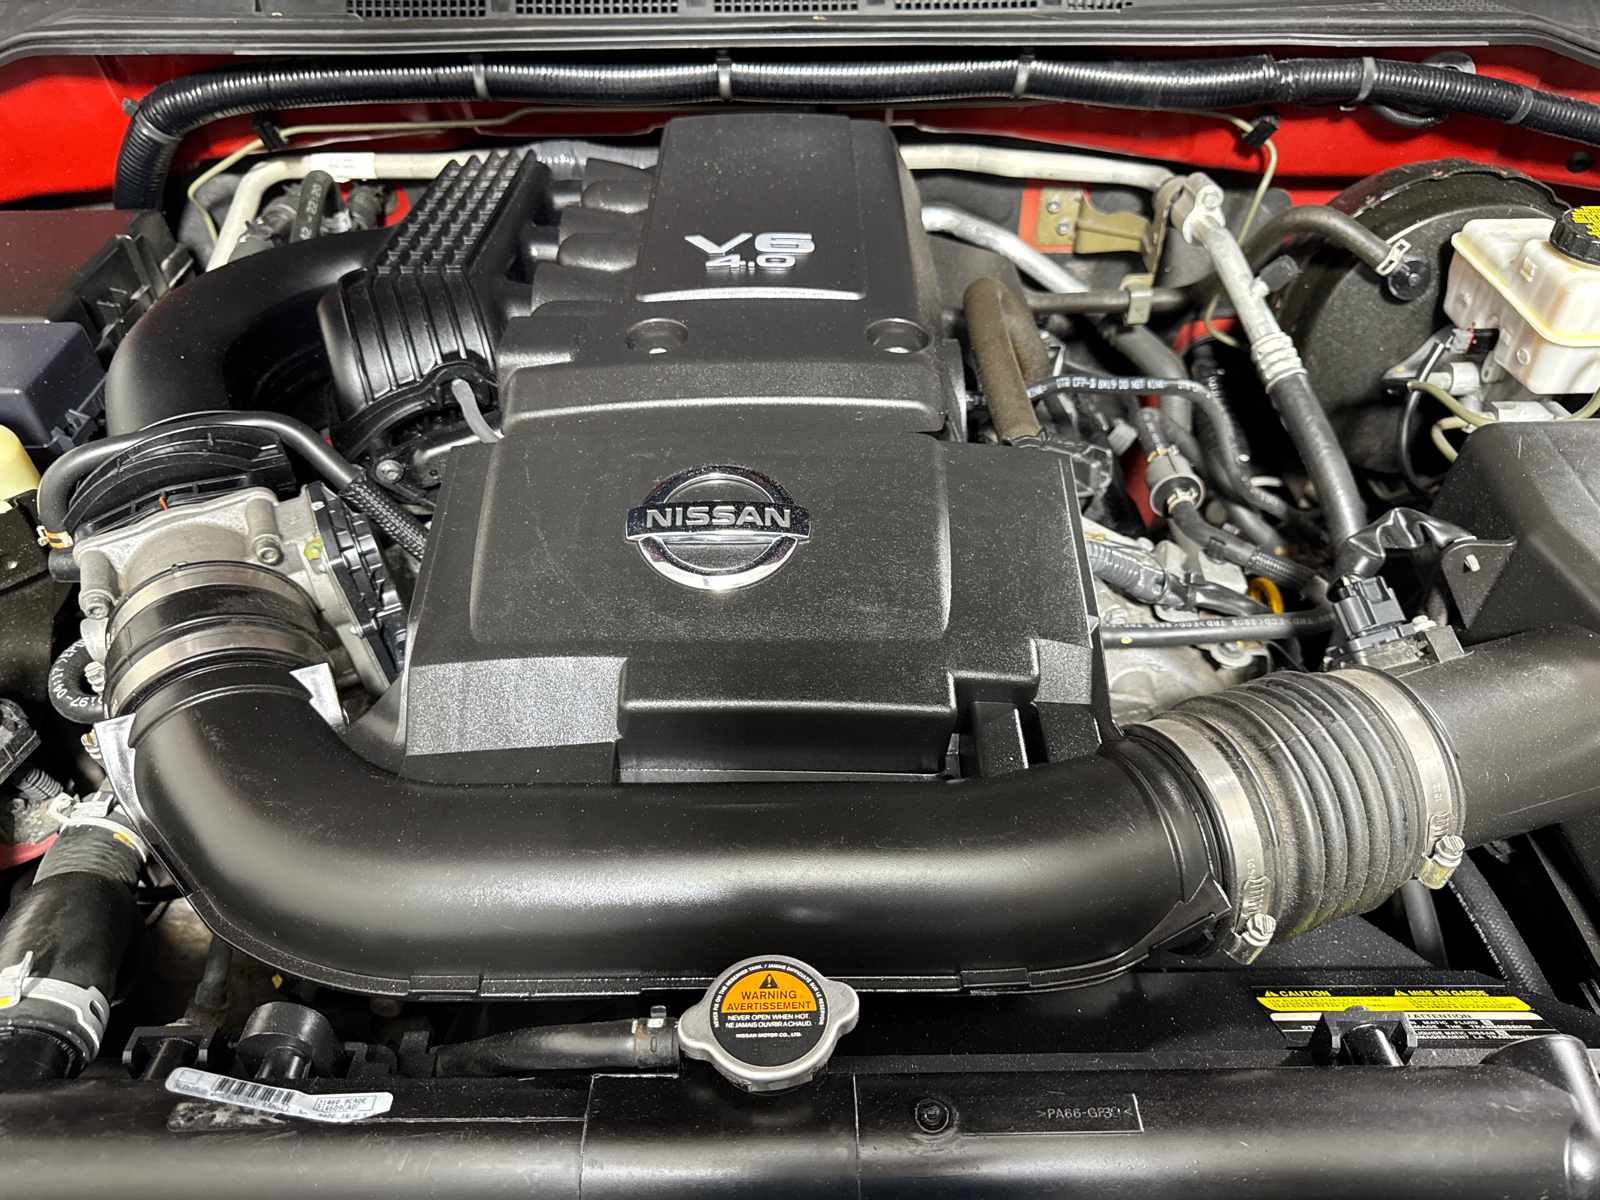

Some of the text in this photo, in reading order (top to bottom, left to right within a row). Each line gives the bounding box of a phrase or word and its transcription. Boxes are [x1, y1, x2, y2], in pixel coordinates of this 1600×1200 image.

[684, 232, 816, 254] V6
[705, 253, 796, 270] 4.0
[646, 506, 791, 528] NISSAN
[741, 990, 797, 1000] WARNING
[727, 1001, 812, 1011] AVERTISSEMENT
